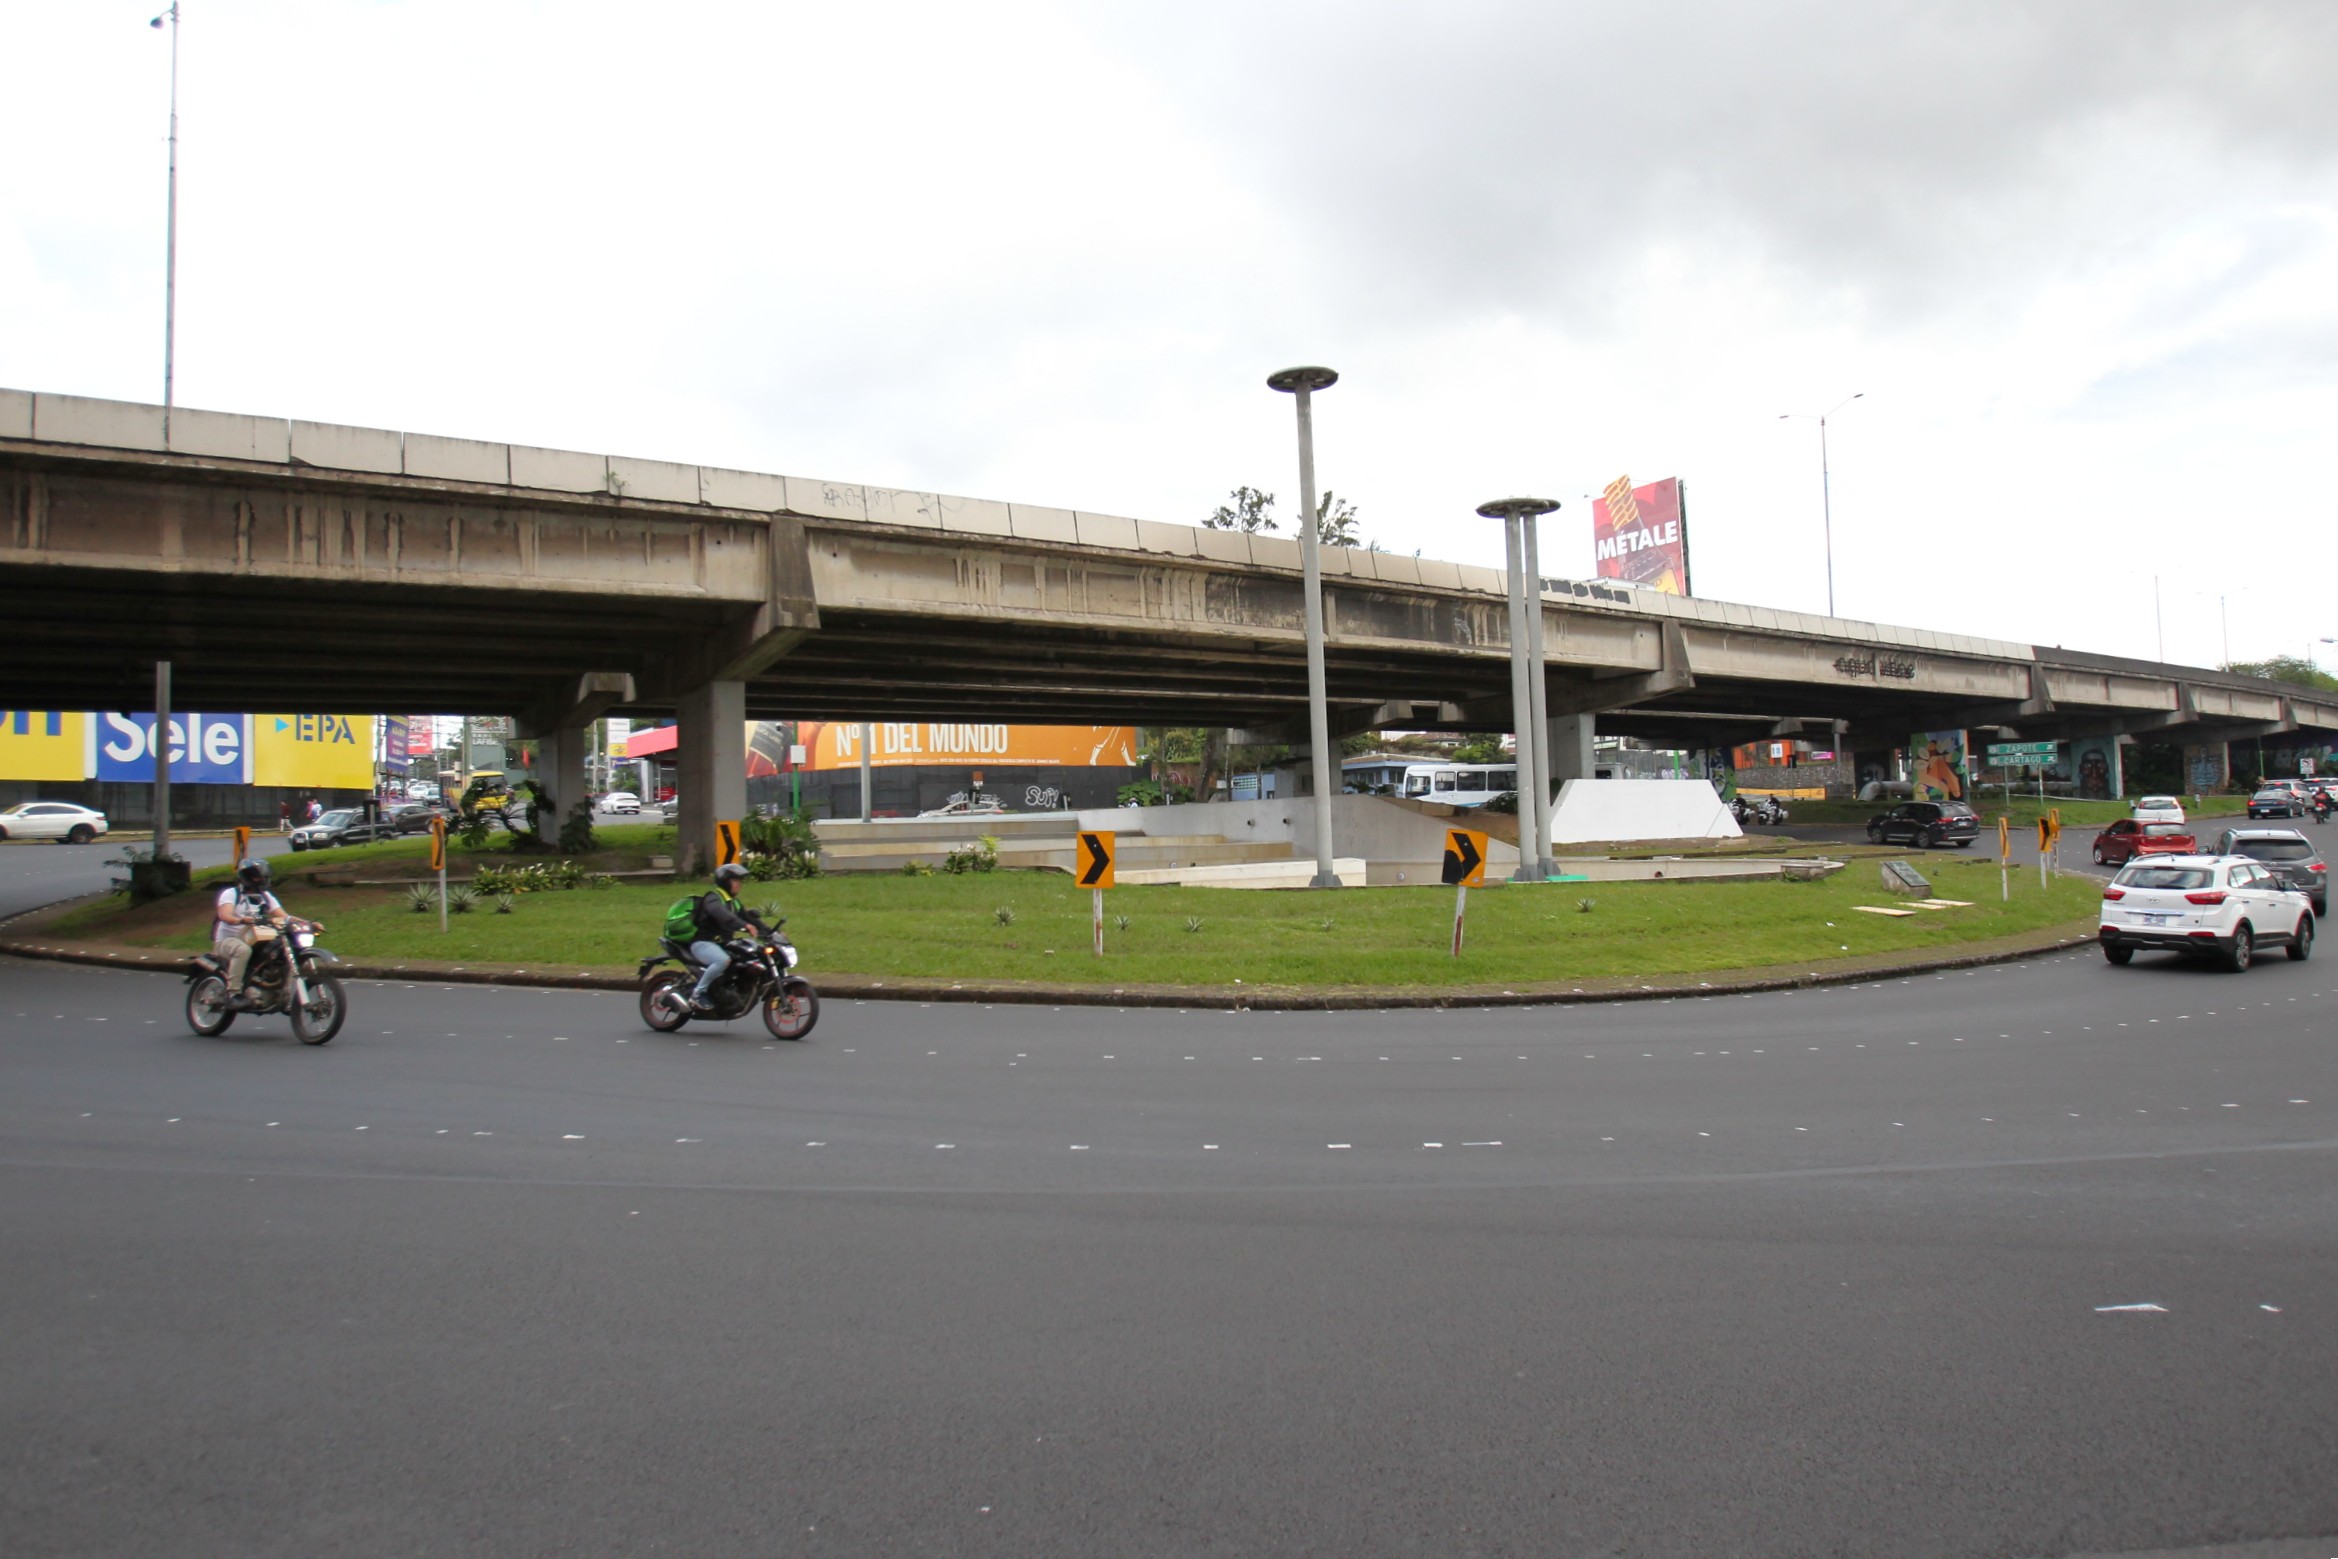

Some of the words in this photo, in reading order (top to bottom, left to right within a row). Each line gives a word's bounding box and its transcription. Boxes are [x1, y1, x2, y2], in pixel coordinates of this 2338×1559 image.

[1597, 521, 1679, 561] MÉTALE
[104, 712, 240, 765] Sele
[296, 714, 356, 744] EPA
[884, 723, 922, 753] DEL
[929, 723, 1008, 754] MUNDO
[2004, 755, 2041, 764] CARTAGO
[2006, 744, 2037, 753] ZAPOTE
